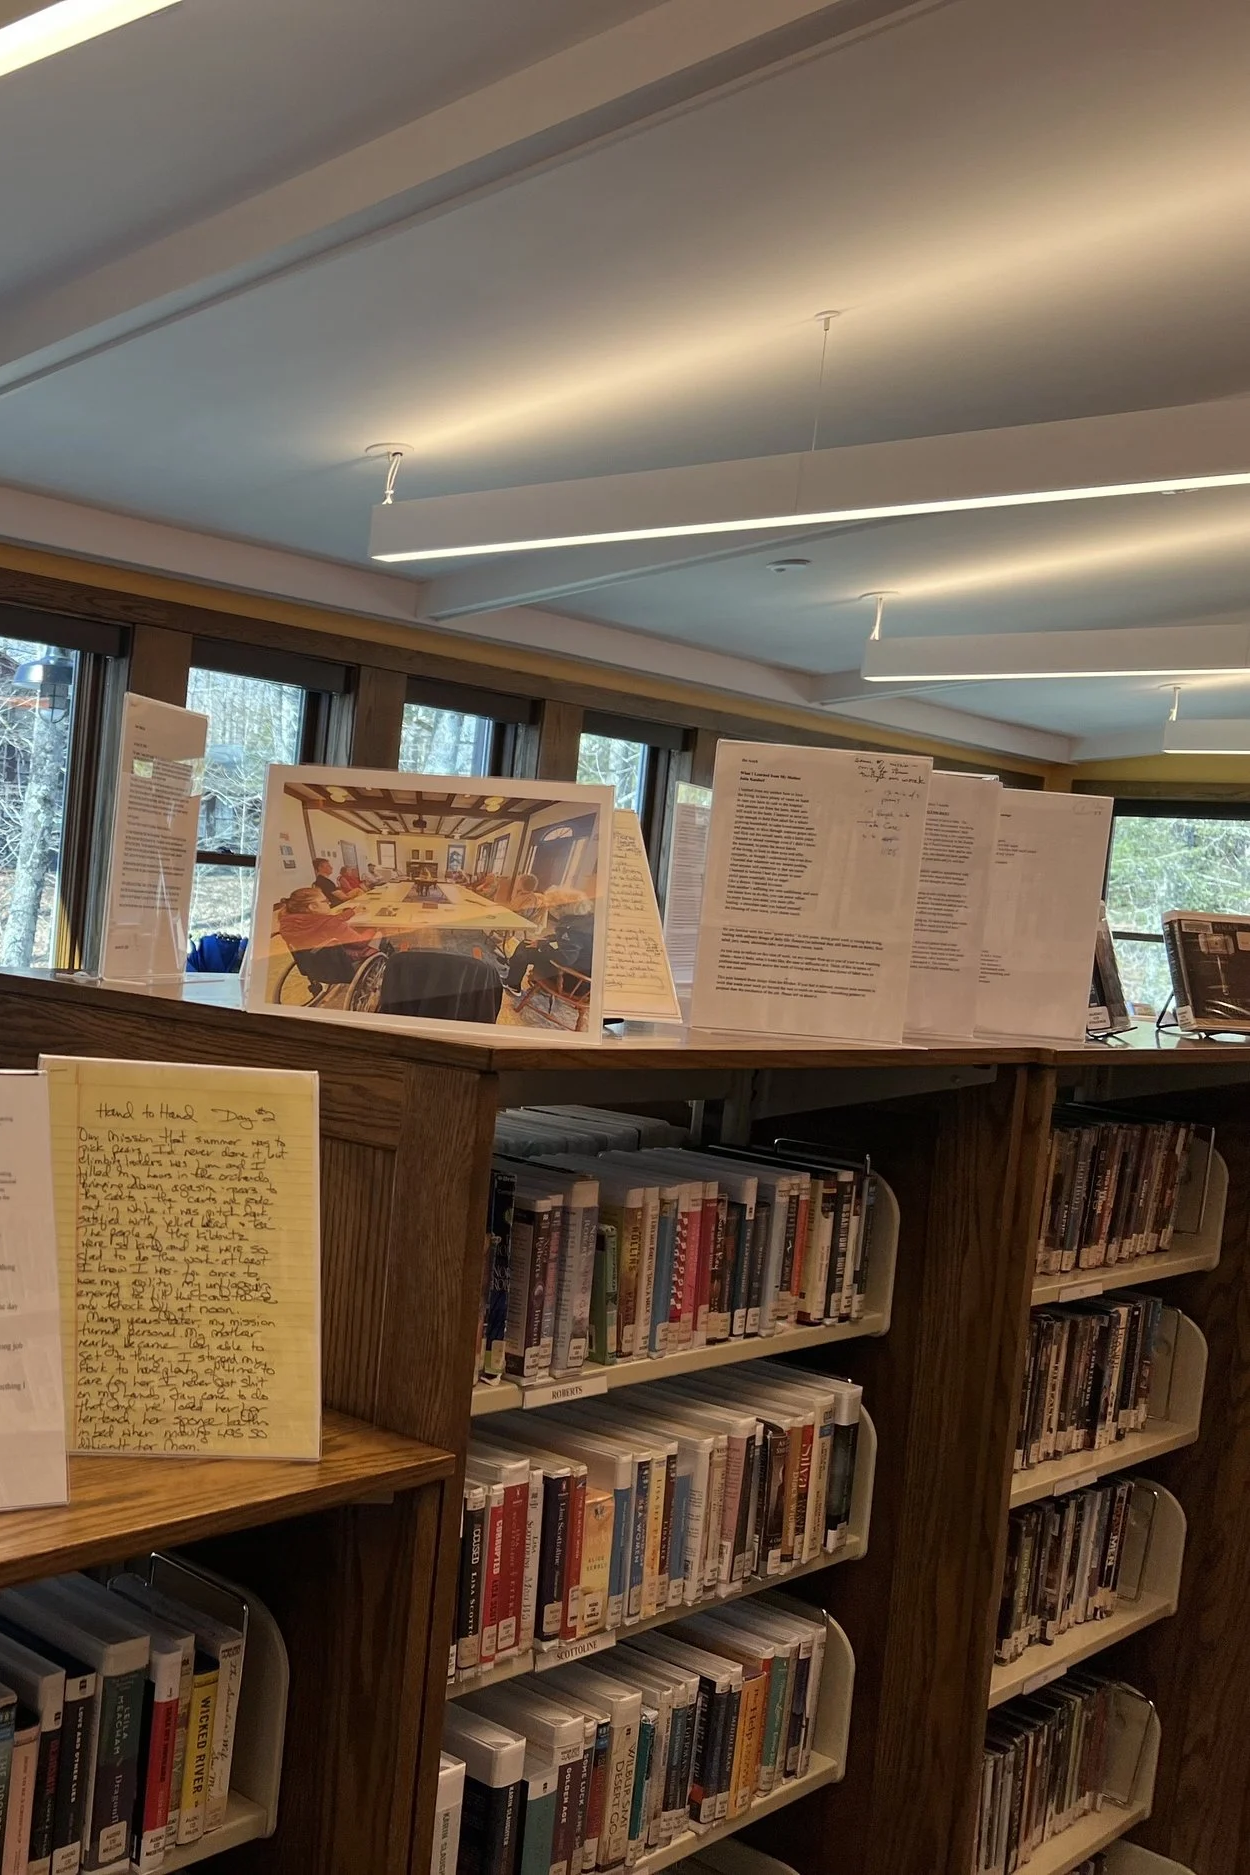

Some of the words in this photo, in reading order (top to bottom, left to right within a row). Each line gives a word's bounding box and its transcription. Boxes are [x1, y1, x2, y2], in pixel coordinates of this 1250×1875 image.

[96, 1101, 134, 1120] Hand
[142, 1104, 155, 1119] to
[160, 1102, 198, 1123] Hand
[211, 1108, 257, 1129] Day
[195, 1135, 242, 1146] summer
[534, 1237, 545, 1278] Roberts
[551, 1385, 583, 1400] ROBERTS
[655, 1478, 663, 1501] LISA
[636, 1499, 645, 1518] SEA
[653, 1505, 661, 1521] SEE
[554, 1521, 564, 1566] Scottoline
[634, 1522, 643, 1563] WOMEN
[661, 1520, 669, 1541] LISA
[492, 1519, 503, 1576] CORRUPTED
[587, 1555, 605, 1564] ALICE
[660, 1543, 668, 1561] SEE
[556, 1641, 598, 1660] SCOTTOLINE
[78, 1705, 86, 1727] LOVE
[113, 1695, 124, 1755] MEACHAM
[121, 1706, 131, 1740] LEILA
[196, 1695, 212, 1749] WICKED
[745, 1707, 758, 1741] Help
[75, 1731, 83, 1750] AND
[725, 1715, 737, 1772] MIDDLEMAN
[72, 1752, 81, 1781] OTHER
[192, 1754, 206, 1794] RIVER
[581, 1752, 590, 1779] SOME
[623, 1744, 637, 1796] WILBUR
[111, 1774, 123, 1822] Dragonfl
[507, 1786, 515, 1808] KARIN
[562, 1767, 573, 1804] GOLDEN
[578, 1781, 587, 1807] LUCK
[612, 1760, 626, 1808] DESERT
[441, 1812, 451, 1840] KARIN
[503, 1808, 513, 1847] SLAUGHTER
[560, 1806, 568, 1825] AGE
[106, 1831, 121, 1840] AUDIO
